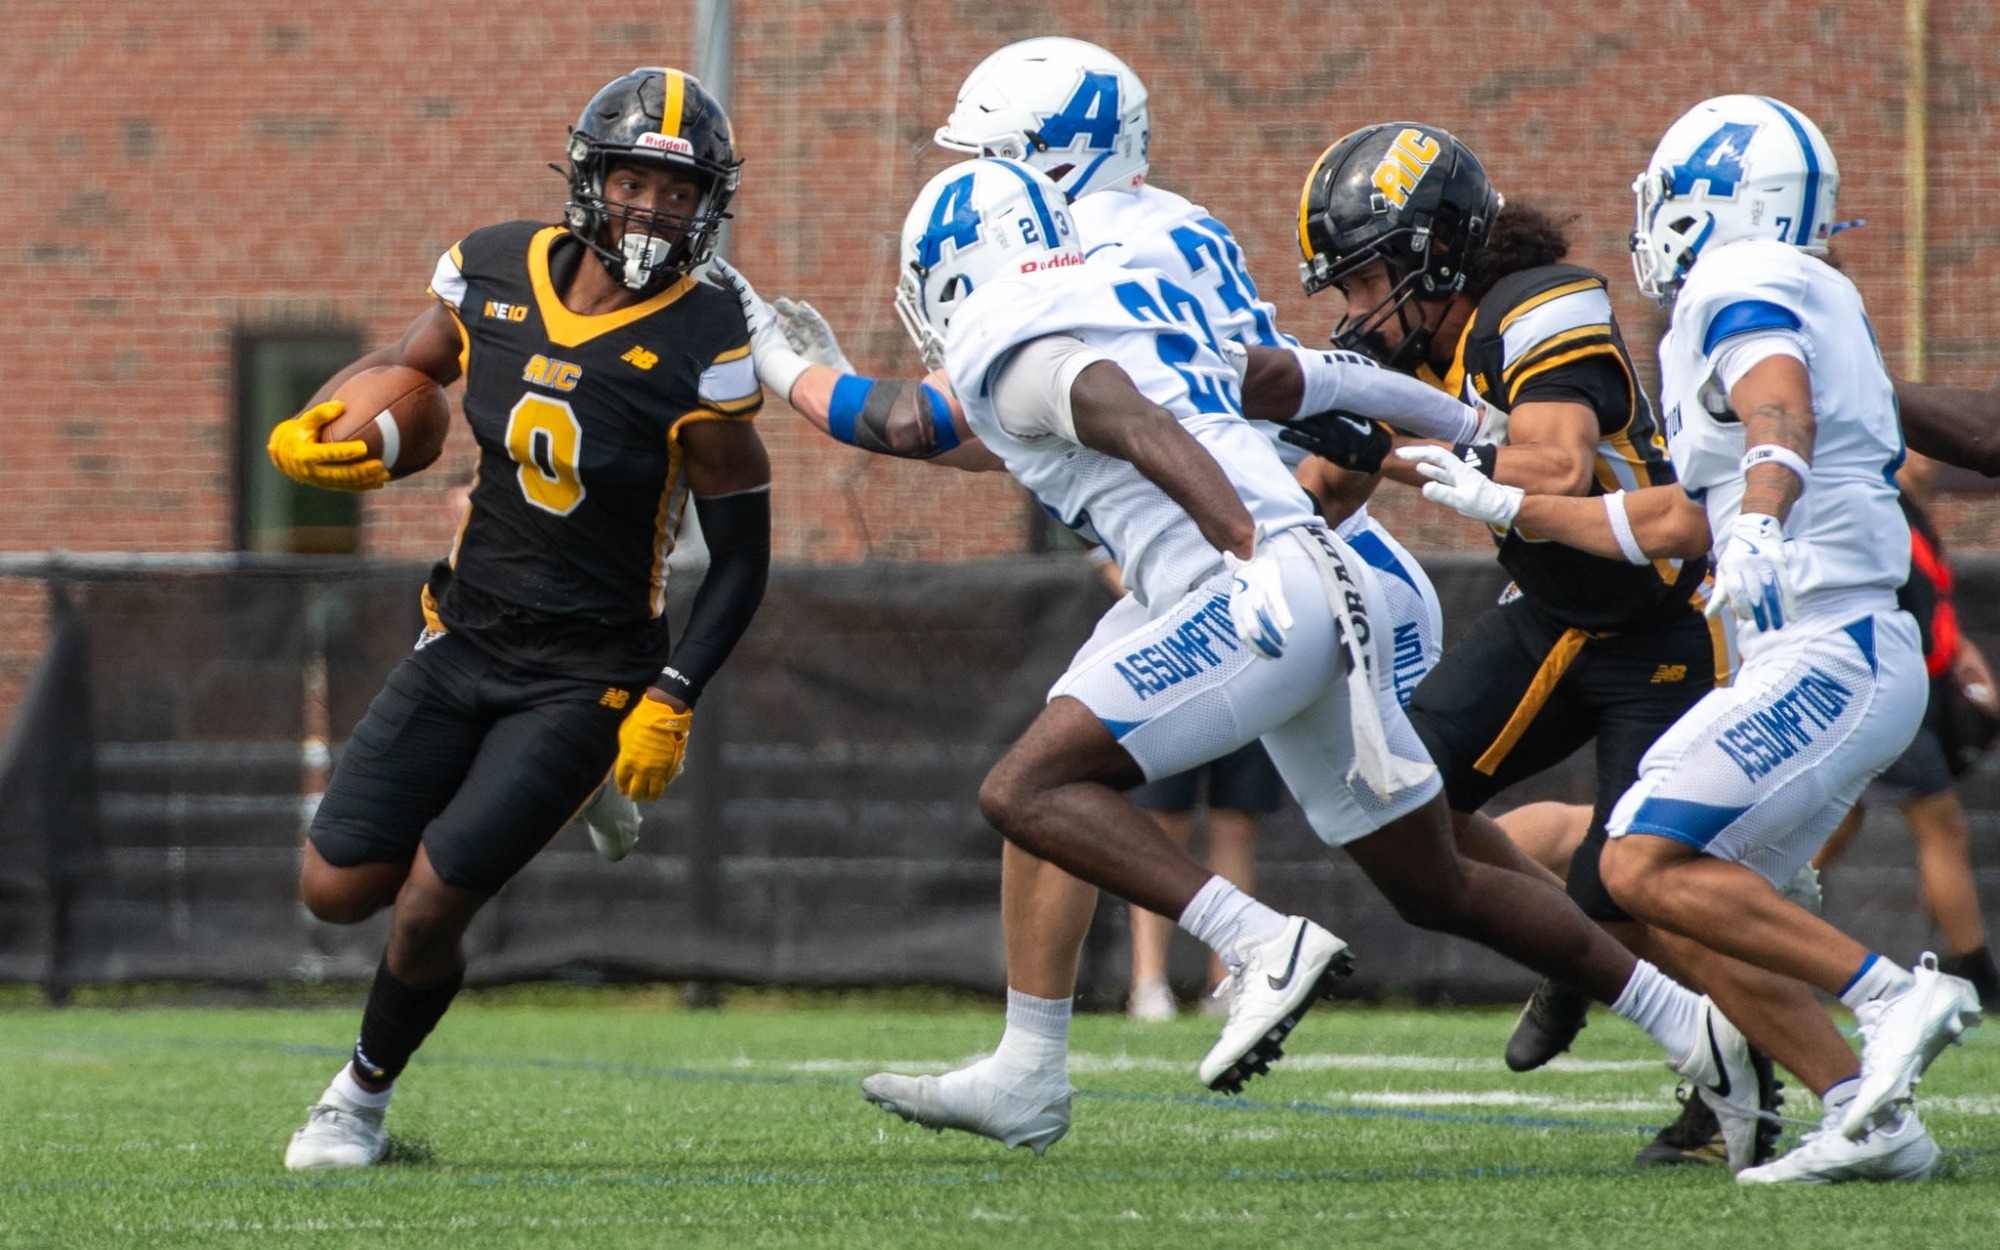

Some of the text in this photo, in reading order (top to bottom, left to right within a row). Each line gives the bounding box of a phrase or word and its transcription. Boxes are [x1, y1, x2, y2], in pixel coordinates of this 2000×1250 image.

[645, 135, 689, 152] Riddell
[1030, 68, 1122, 151] A
[1671, 121, 1759, 198] A
[915, 171, 983, 271] A
[1775, 216, 1792, 242] 7
[483, 299, 529, 323] NE10
[504, 390, 587, 517] 0
[1715, 666, 1854, 784] ASSUMPTION
